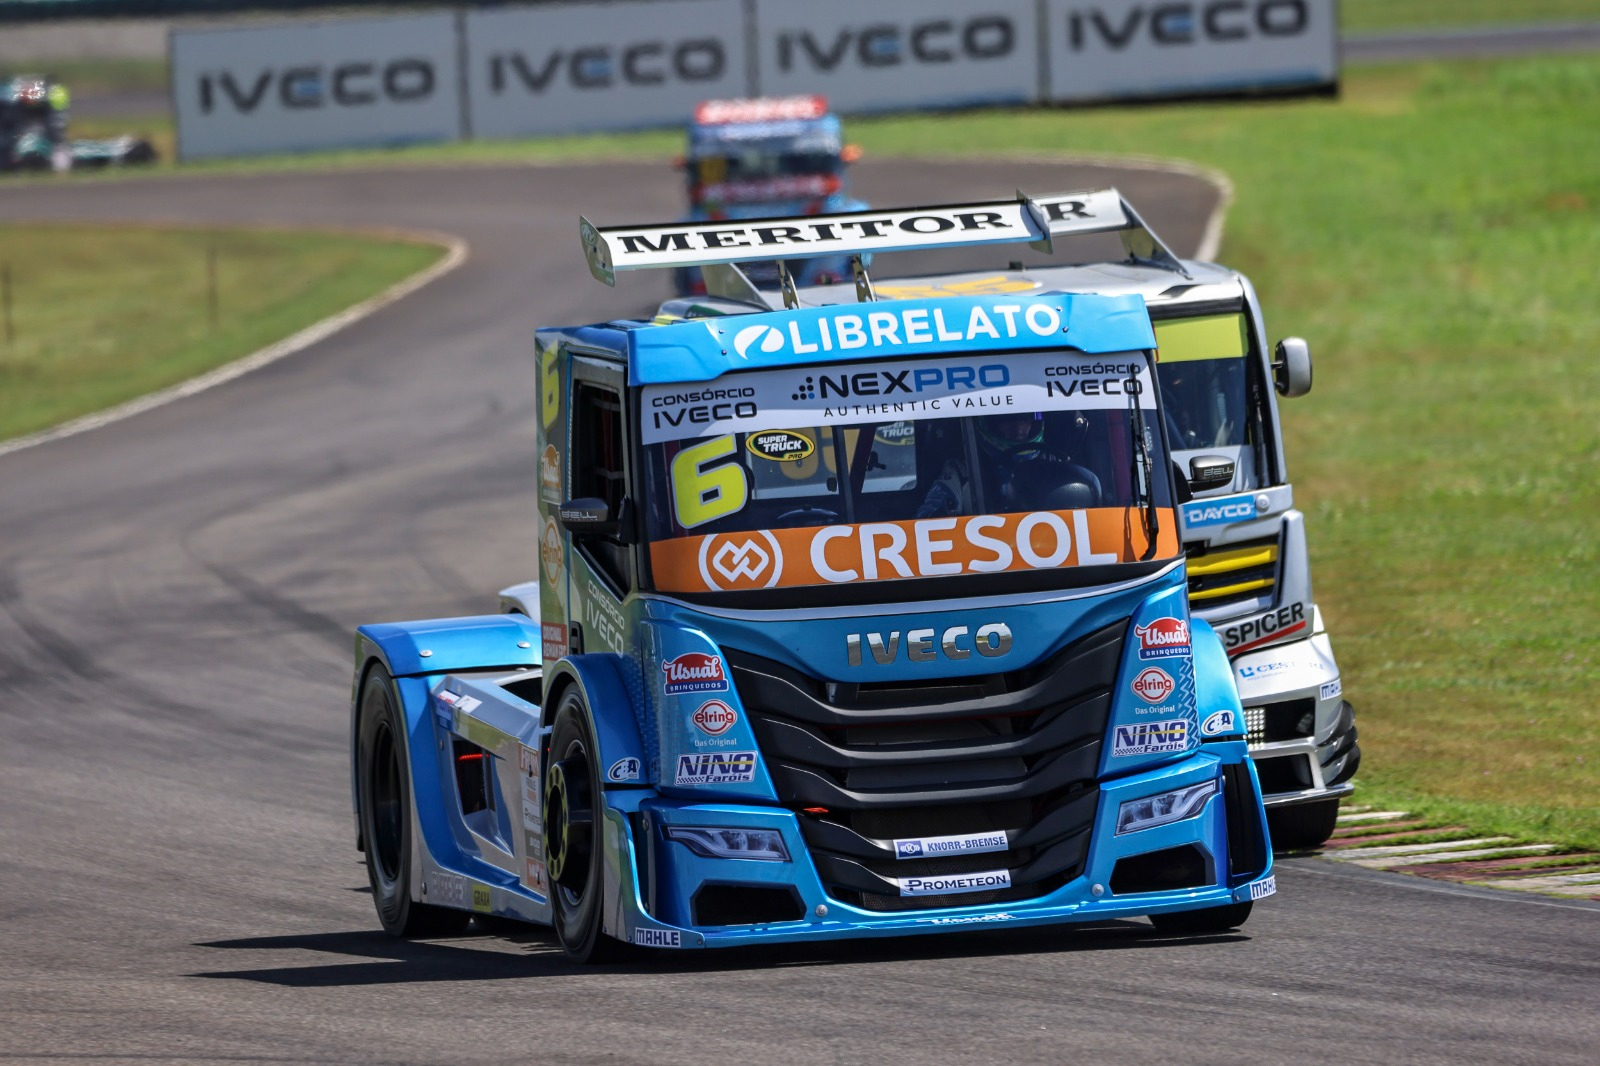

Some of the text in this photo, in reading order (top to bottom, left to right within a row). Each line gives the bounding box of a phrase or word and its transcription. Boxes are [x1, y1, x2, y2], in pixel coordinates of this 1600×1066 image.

[1069, 0, 1310, 52] IVECO
[777, 15, 1016, 72] IVECO
[489, 36, 726, 92] IVECO
[201, 58, 436, 115] IVECO
[617, 211, 1013, 255] MERITOR
[788, 303, 1062, 355] LIBRELATO
[1044, 363, 1141, 377] CONSÓRCIO
[541, 338, 559, 432] 6
[819, 364, 1010, 399] NEXPRO
[1046, 378, 1143, 398] IVECO
[652, 387, 755, 407] CONSÓRCIO
[823, 394, 1014, 417] AUTHENTIC VALUE
[653, 401, 757, 429] IVECO
[758, 434, 788, 445] SUPER
[763, 440, 803, 453] TRUCK
[670, 432, 748, 529] 6
[1189, 503, 1251, 523] DAYCO
[810, 509, 1117, 583] CRESOL
[586, 598, 624, 659] IVECO
[1225, 602, 1304, 647] SPICER
[846, 622, 1013, 667] IVECO
[1146, 647, 1189, 657] BRINQUEDOS
[670, 682, 721, 692] BRINQUEDOS
[1134, 676, 1172, 692] elring
[694, 711, 734, 728] elring
[1135, 705, 1175, 715] Das Original
[694, 737, 737, 748] Das Original
[928, 836, 1006, 852] KNORR-BREMSE
[904, 874, 1007, 892] PROMETEON
[636, 928, 679, 946] MAHLE
